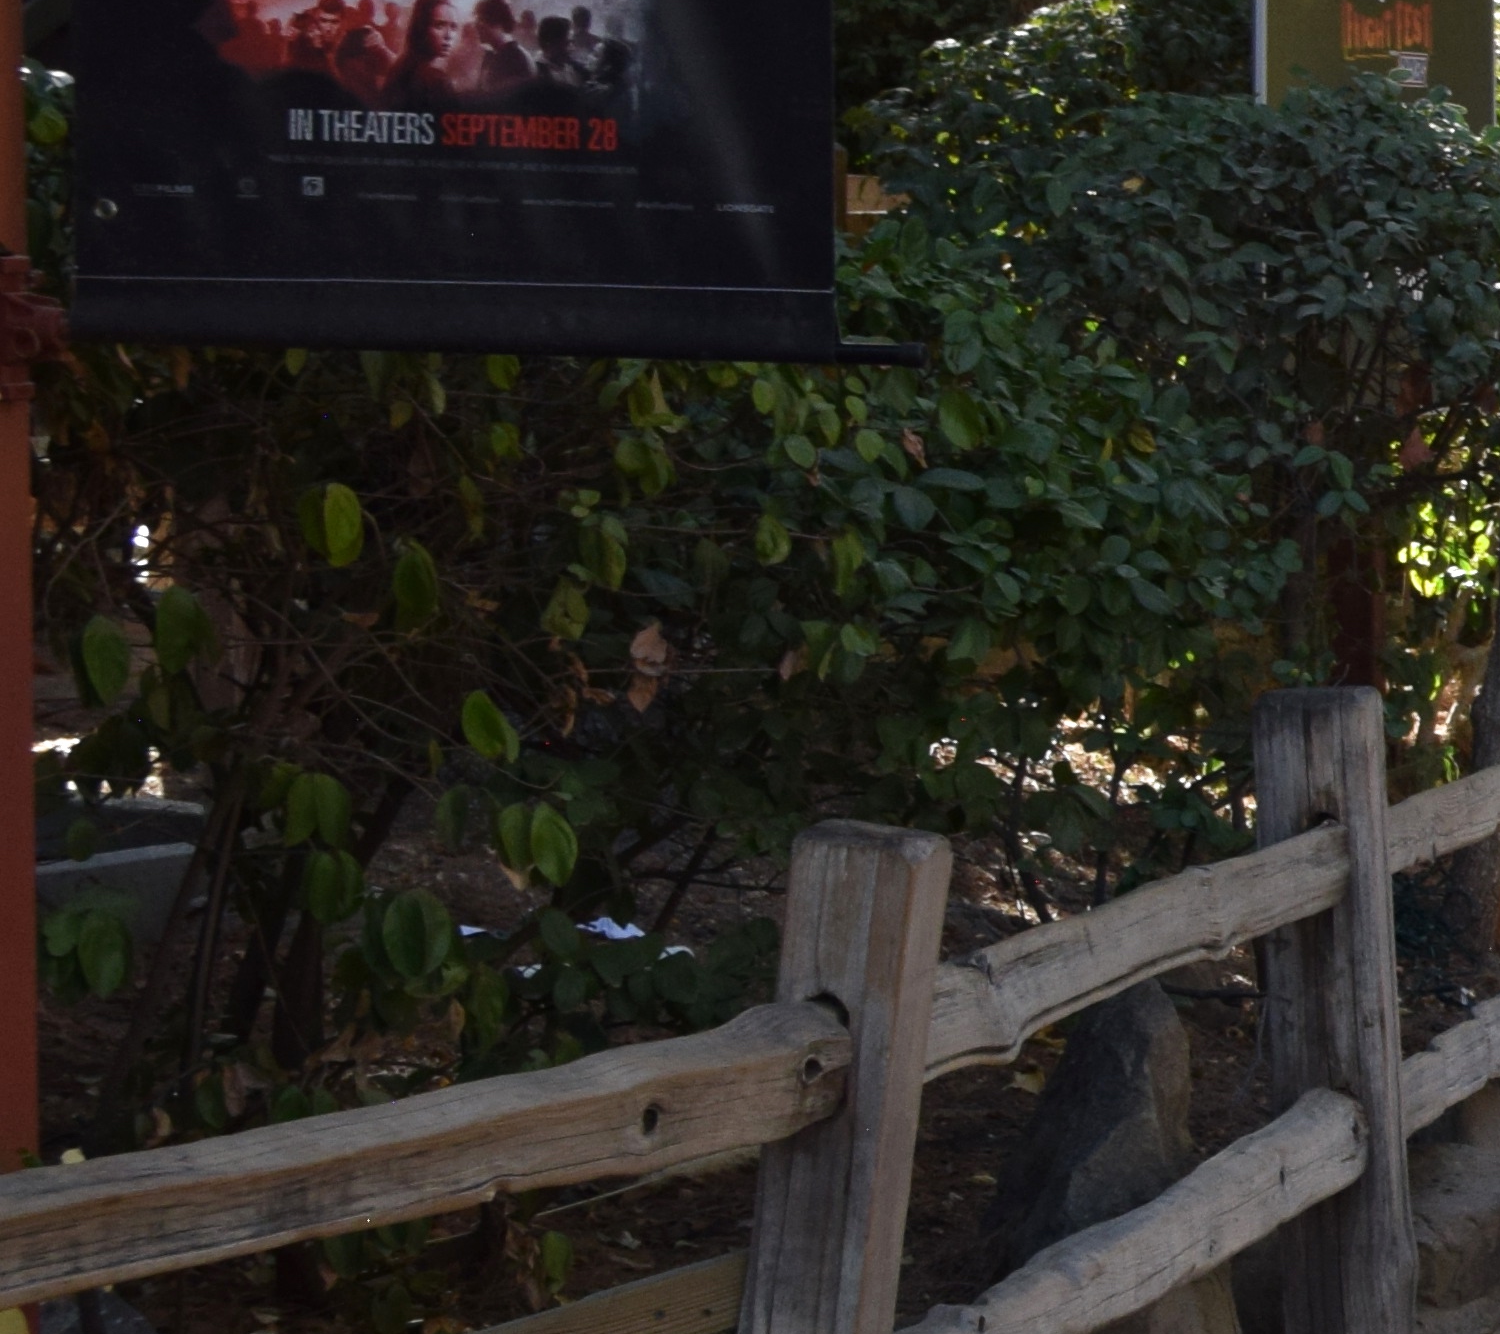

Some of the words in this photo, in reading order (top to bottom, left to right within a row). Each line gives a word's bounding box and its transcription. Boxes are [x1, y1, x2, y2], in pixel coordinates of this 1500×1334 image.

[288, 107, 314, 141] IN
[317, 108, 436, 145] THEATERS
[441, 113, 581, 150] SEPTEMBER
[587, 115, 618, 152] 28
